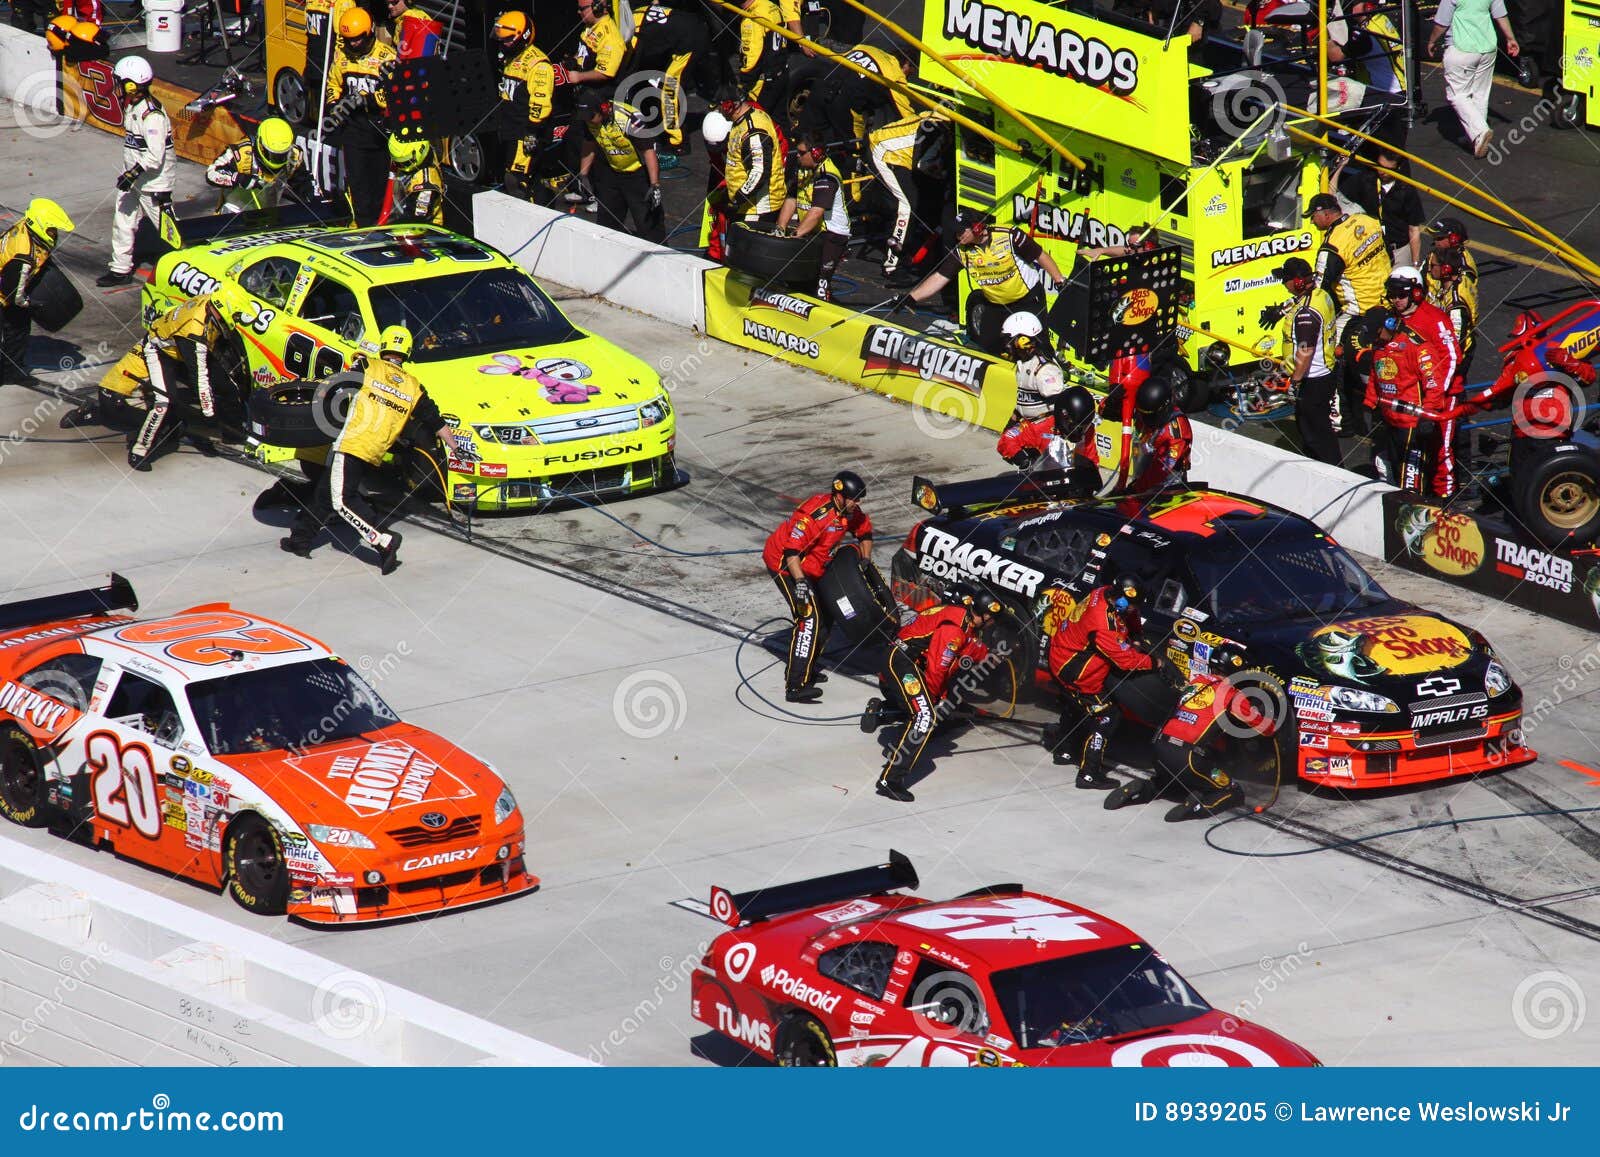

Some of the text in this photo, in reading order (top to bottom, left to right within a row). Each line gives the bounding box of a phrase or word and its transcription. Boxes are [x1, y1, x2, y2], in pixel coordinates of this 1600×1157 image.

[944, 0, 1138, 96] MENARDS
[347, 75, 378, 98] CAT
[1203, 202, 1228, 213] YATES
[1013, 193, 1131, 249] MENARD
[1212, 232, 1313, 269] MENARDS
[1242, 279, 1265, 290] Johns
[753, 286, 812, 317] Energizer
[743, 318, 820, 359] MENARDS
[869, 325, 983, 384] Energizer
[501, 428, 523, 442] 98
[543, 443, 643, 466] FUSION
[1436, 519, 1461, 543] Pro
[919, 526, 1045, 598] TRACKER
[1433, 536, 1480, 570] Shops
[1495, 537, 1574, 583] TRACKER
[1524, 570, 1572, 594] BOATS
[799, 617, 814, 658] TRACKER
[1383, 635, 1466, 661] Shops
[1288, 684, 1325, 697] MOOG
[1296, 696, 1334, 711] MAHLE
[0, 679, 70, 733] DEPOT
[915, 694, 931, 733] TRACKER
[1299, 709, 1326, 720] COMP
[1411, 703, 1490, 729] IMPALA SS
[1300, 733, 1328, 746] JE
[327, 755, 362, 780] THE
[1331, 757, 1350, 769] WIX
[85, 729, 162, 841] 20
[344, 741, 416, 812] HOME
[397, 757, 438, 803] DEPOT
[327, 828, 351, 845] 20
[285, 847, 320, 861] MAHLE
[402, 846, 480, 872] CAMRY
[772, 968, 842, 1015] Polaroid
[716, 1001, 773, 1053] TUMS
